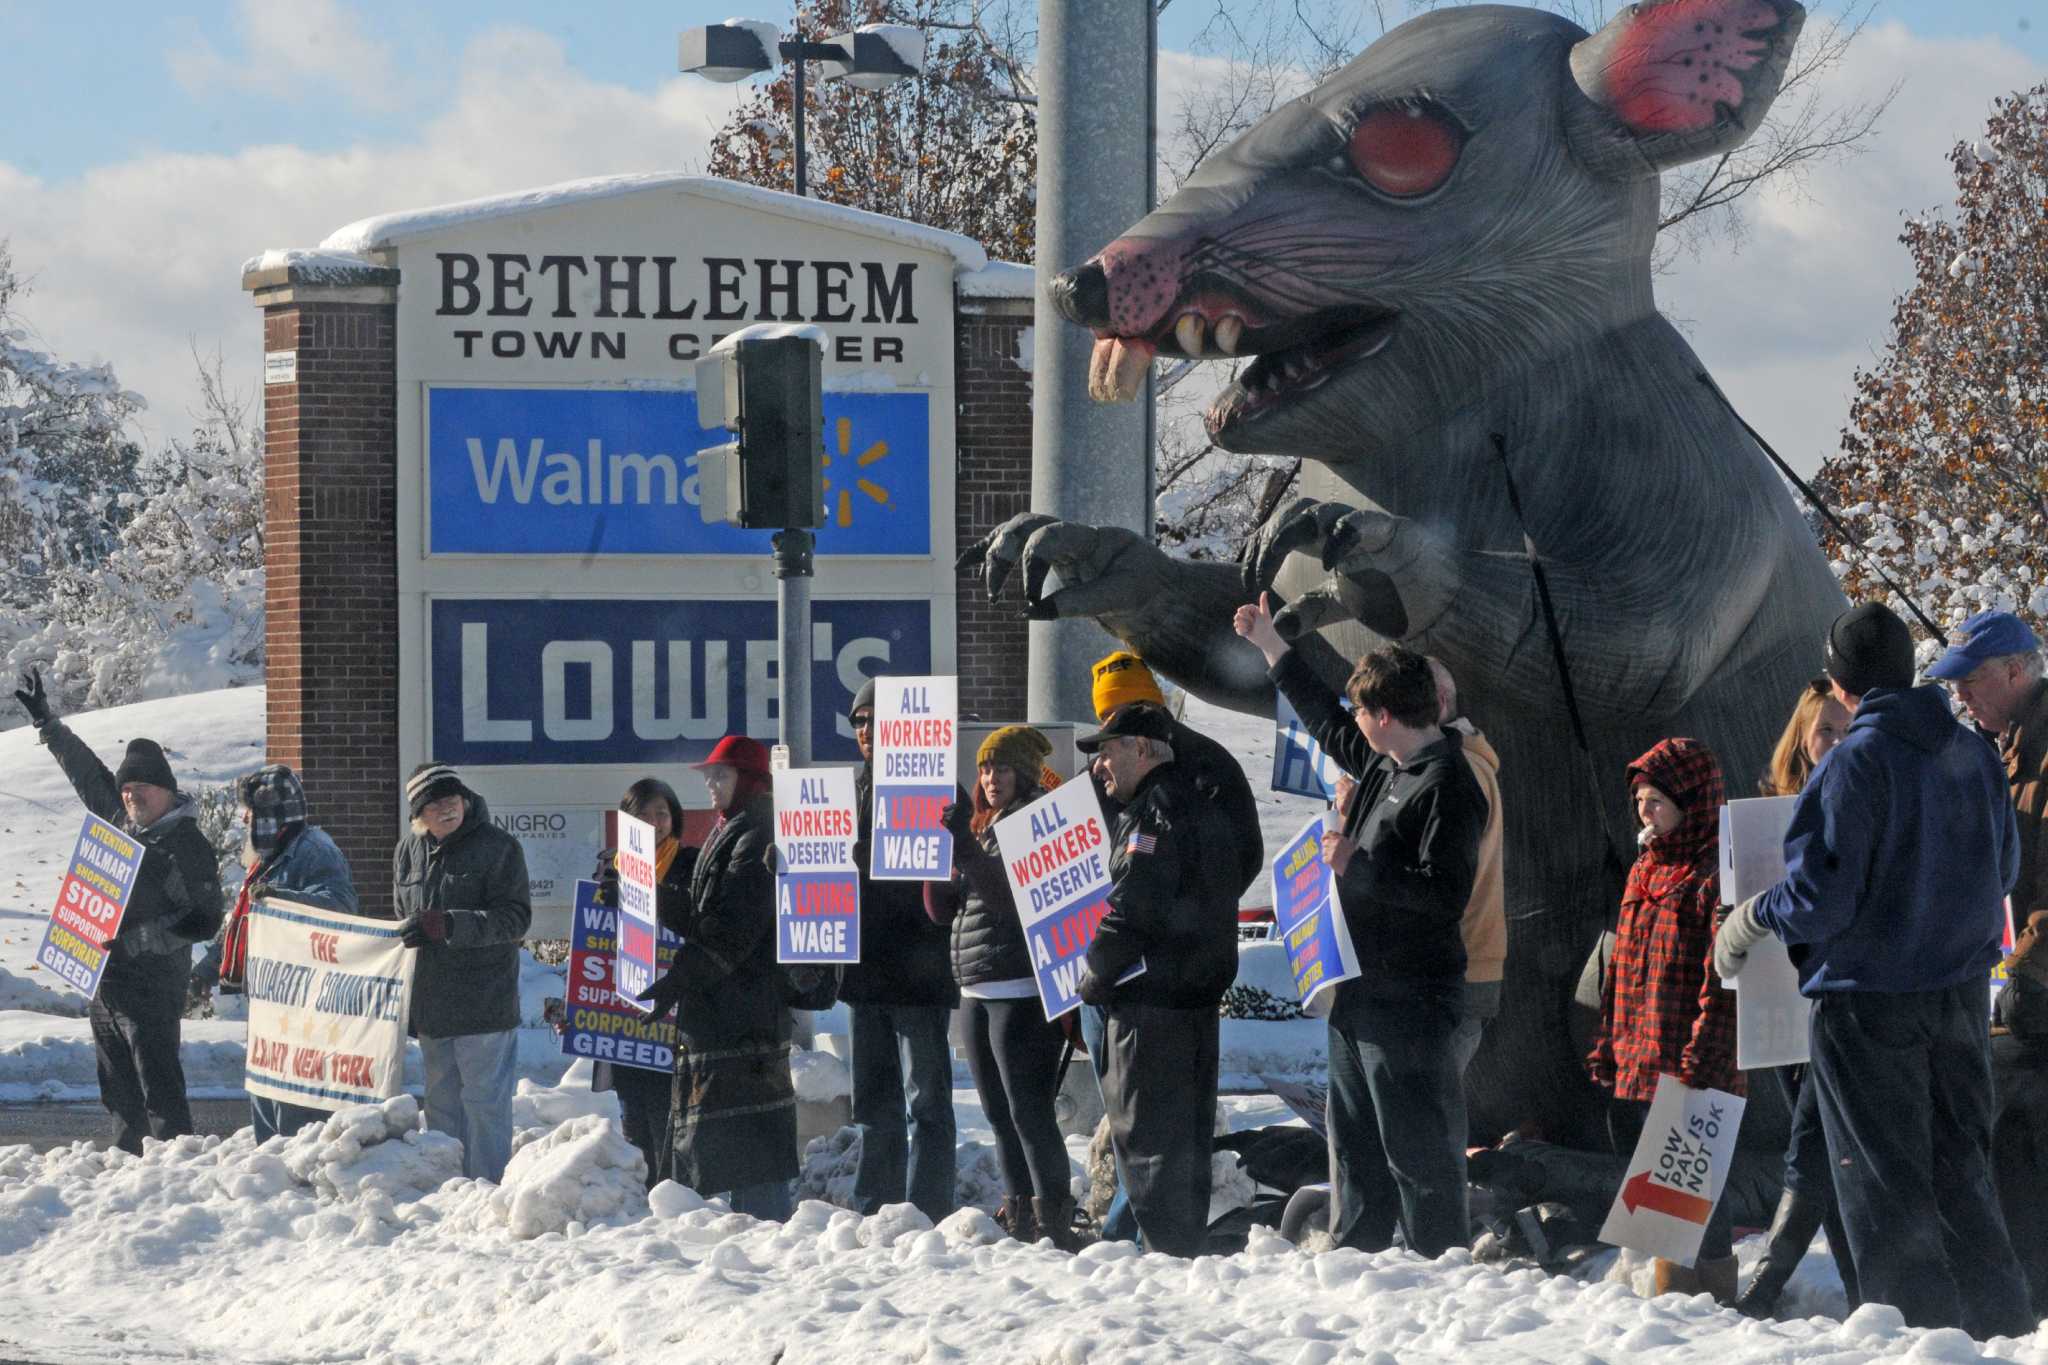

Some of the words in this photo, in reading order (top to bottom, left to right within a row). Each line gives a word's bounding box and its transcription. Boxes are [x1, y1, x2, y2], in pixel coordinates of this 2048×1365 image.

[435, 253, 918, 324] BETHLEHEM
[454, 330, 626, 360] TOWN
[668, 331, 905, 364] CER
[466, 438, 700, 506] Walm
[901, 687, 930, 714] ALL
[880, 719, 952, 747] WORKERS
[886, 753, 945, 777] DESERVE
[800, 778, 829, 804] ALL
[494, 814, 566, 831] NIGRO
[780, 809, 852, 837] WORKERS
[876, 797, 887, 830] A
[1030, 801, 1067, 842] ALL
[89, 823, 134, 860] ATTENTION
[629, 825, 643, 854] ALL
[788, 841, 847, 865] DESERVE
[883, 836, 939, 870] WAGE
[1011, 817, 1103, 888] WORKERS
[79, 838, 132, 885] WALMART
[619, 853, 653, 888] WORKERS
[75, 863, 121, 900] SHOPPERS
[622, 880, 651, 917] DESERVE
[780, 883, 792, 915] A
[795, 880, 855, 916] LIVING
[1030, 854, 1104, 913] DESERVE
[66, 880, 116, 925] STOP
[49, 926, 102, 971] CORPORATE
[309, 931, 340, 964] THE
[789, 921, 847, 953] WAGE
[1034, 934, 1052, 970] A
[43, 945, 92, 990] GREED
[292, 1047, 327, 1082] NEW
[331, 1054, 375, 1089] YORK
[573, 1032, 673, 1068] GREED
[1654, 1127, 1684, 1182] LOW
[1670, 1143, 1696, 1188] PAY
[1688, 1115, 1705, 1140] IS
[1687, 1144, 1713, 1193] NOT
[1705, 1103, 1724, 1139] OK
